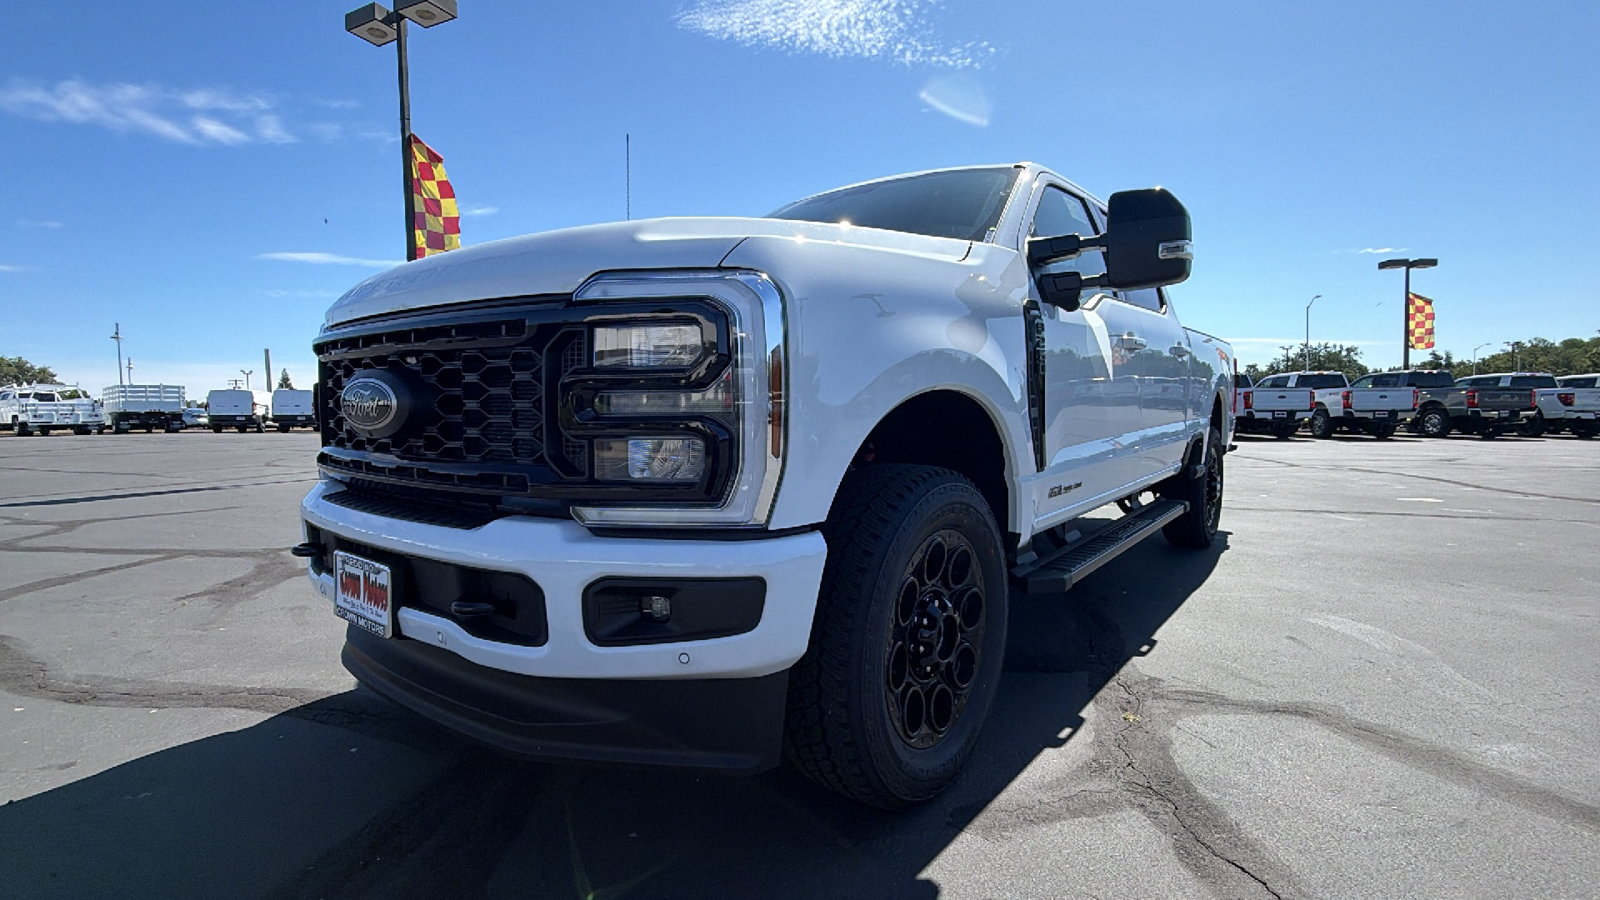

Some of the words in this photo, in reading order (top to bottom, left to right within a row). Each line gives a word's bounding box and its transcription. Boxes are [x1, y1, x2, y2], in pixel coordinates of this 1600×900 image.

[349, 388, 379, 417] Ford
[336, 607, 358, 623] CROWN
[357, 616, 385, 636] MOTORS
